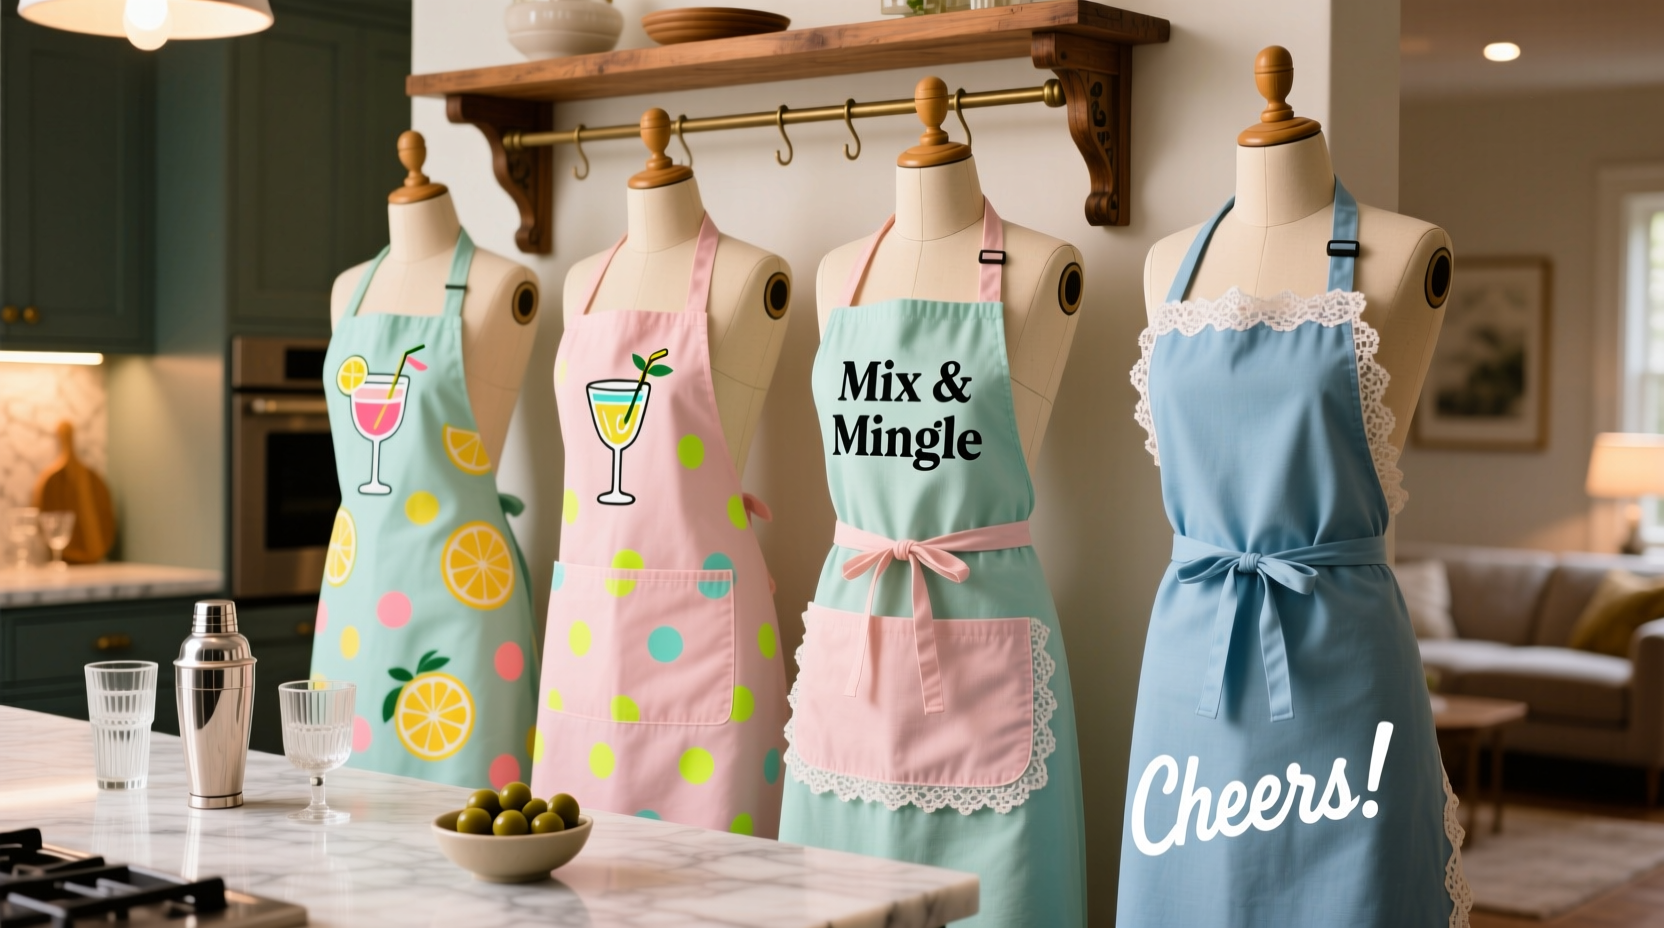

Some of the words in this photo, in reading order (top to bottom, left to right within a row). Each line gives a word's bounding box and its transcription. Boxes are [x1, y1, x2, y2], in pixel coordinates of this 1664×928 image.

[838, 359, 922, 403] Mix
[932, 360, 973, 404] &
[832, 414, 983, 472] Mingle
[1131, 721, 1394, 857] Cheers!
